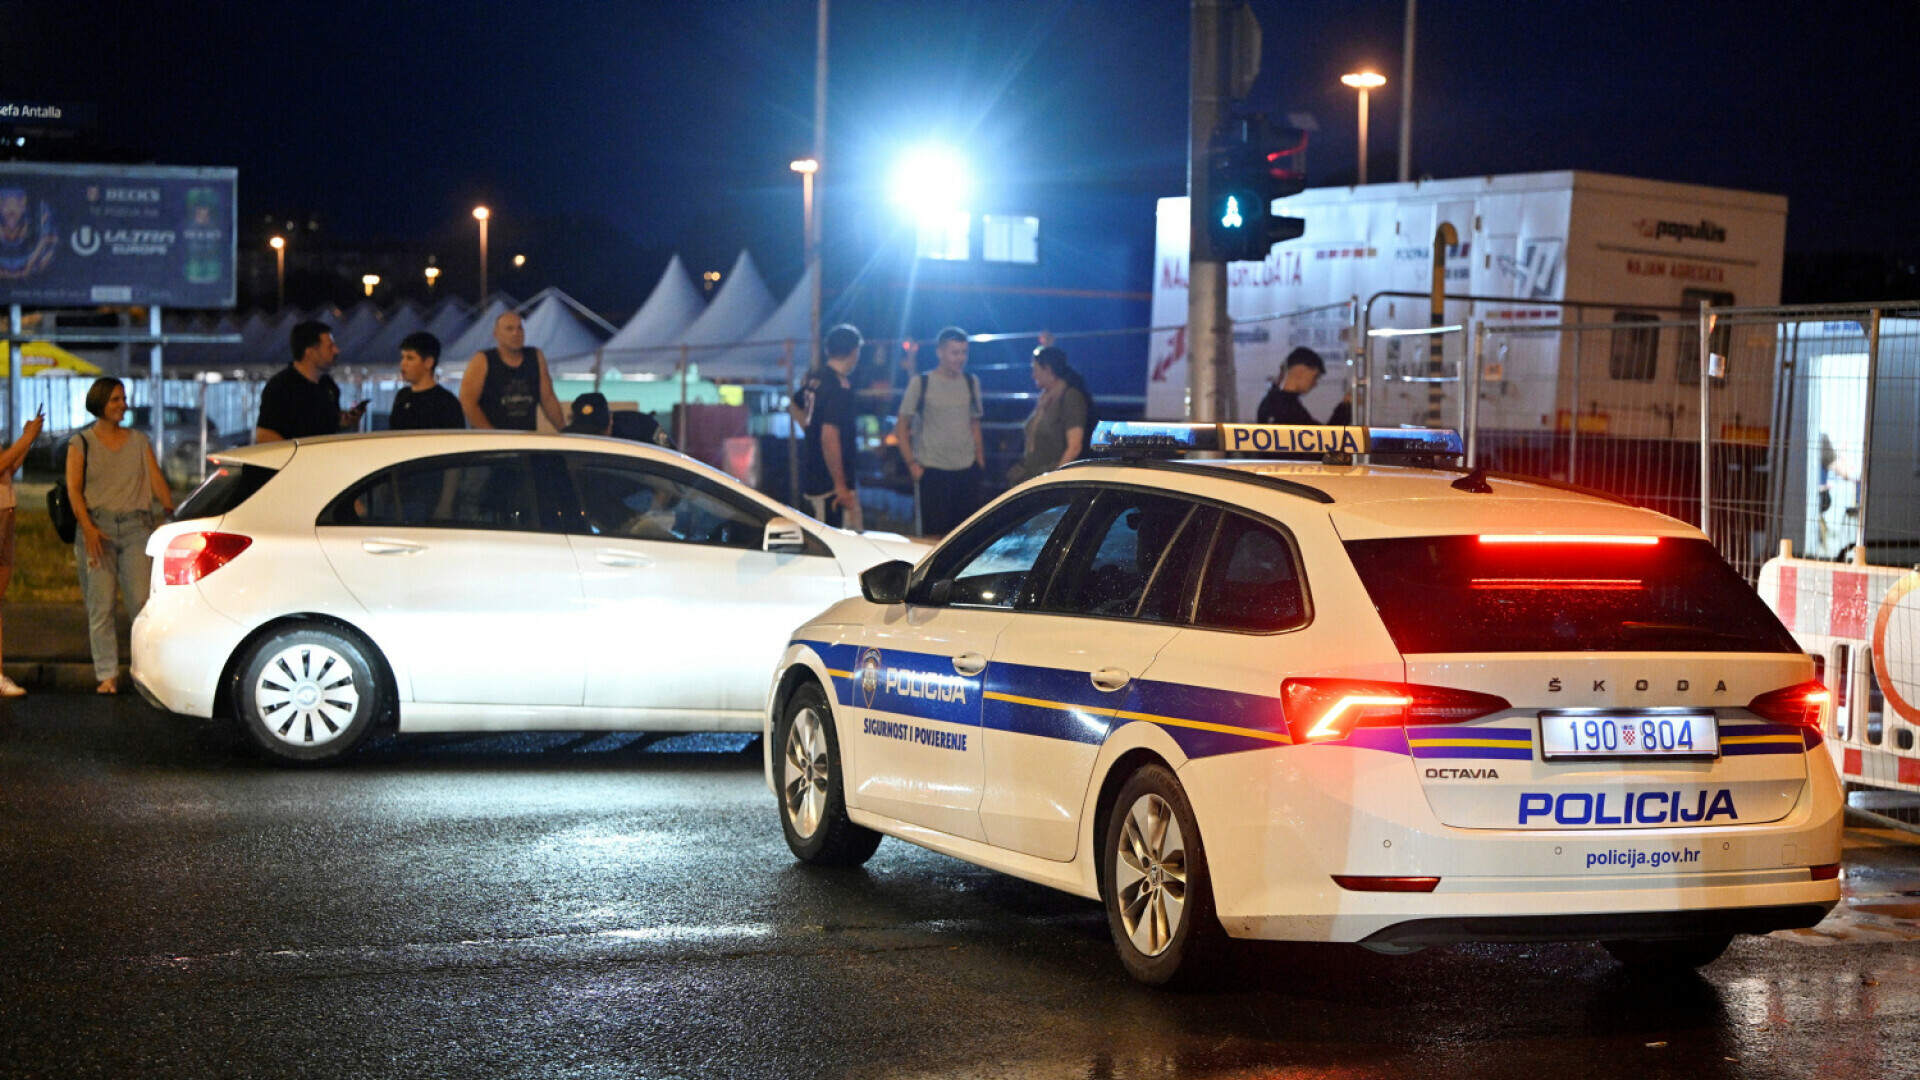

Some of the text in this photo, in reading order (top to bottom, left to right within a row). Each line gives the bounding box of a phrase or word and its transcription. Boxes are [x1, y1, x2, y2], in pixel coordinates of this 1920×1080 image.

[21, 104, 62, 119] Antalla
[1233, 428, 1359, 453] POLICIJA
[885, 667, 967, 705] POLICIJA
[1548, 676, 1728, 693] ŠKODA
[863, 717, 908, 742] SIGURNOST
[914, 726, 967, 752] POVJERENJE
[1569, 719, 1694, 751] 190 804
[1425, 768, 1499, 780] OCTAVIA
[1518, 789, 1738, 825] POLICIJA
[1585, 847, 1701, 868] policija.gov.hr
